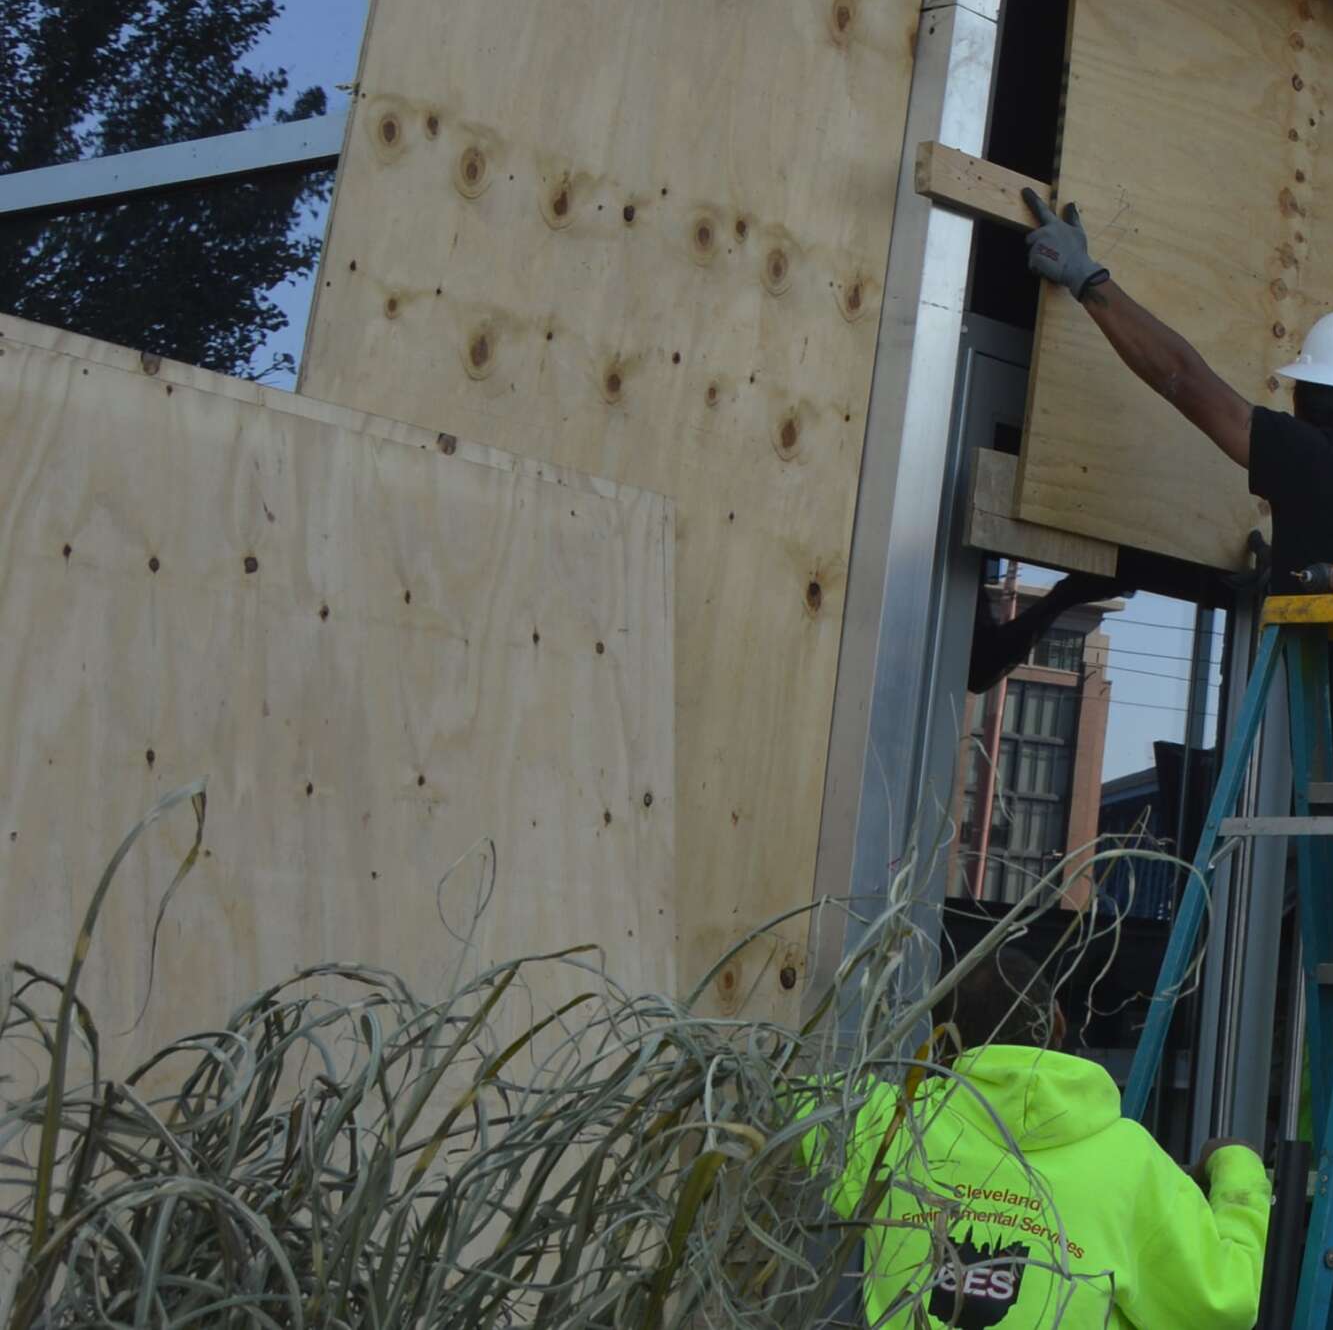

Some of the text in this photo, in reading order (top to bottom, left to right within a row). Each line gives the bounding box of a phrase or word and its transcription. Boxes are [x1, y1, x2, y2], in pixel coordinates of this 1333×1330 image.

[954, 1183, 1043, 1211] Cleveland
[902, 1208, 1085, 1259] Envirmental Servies
